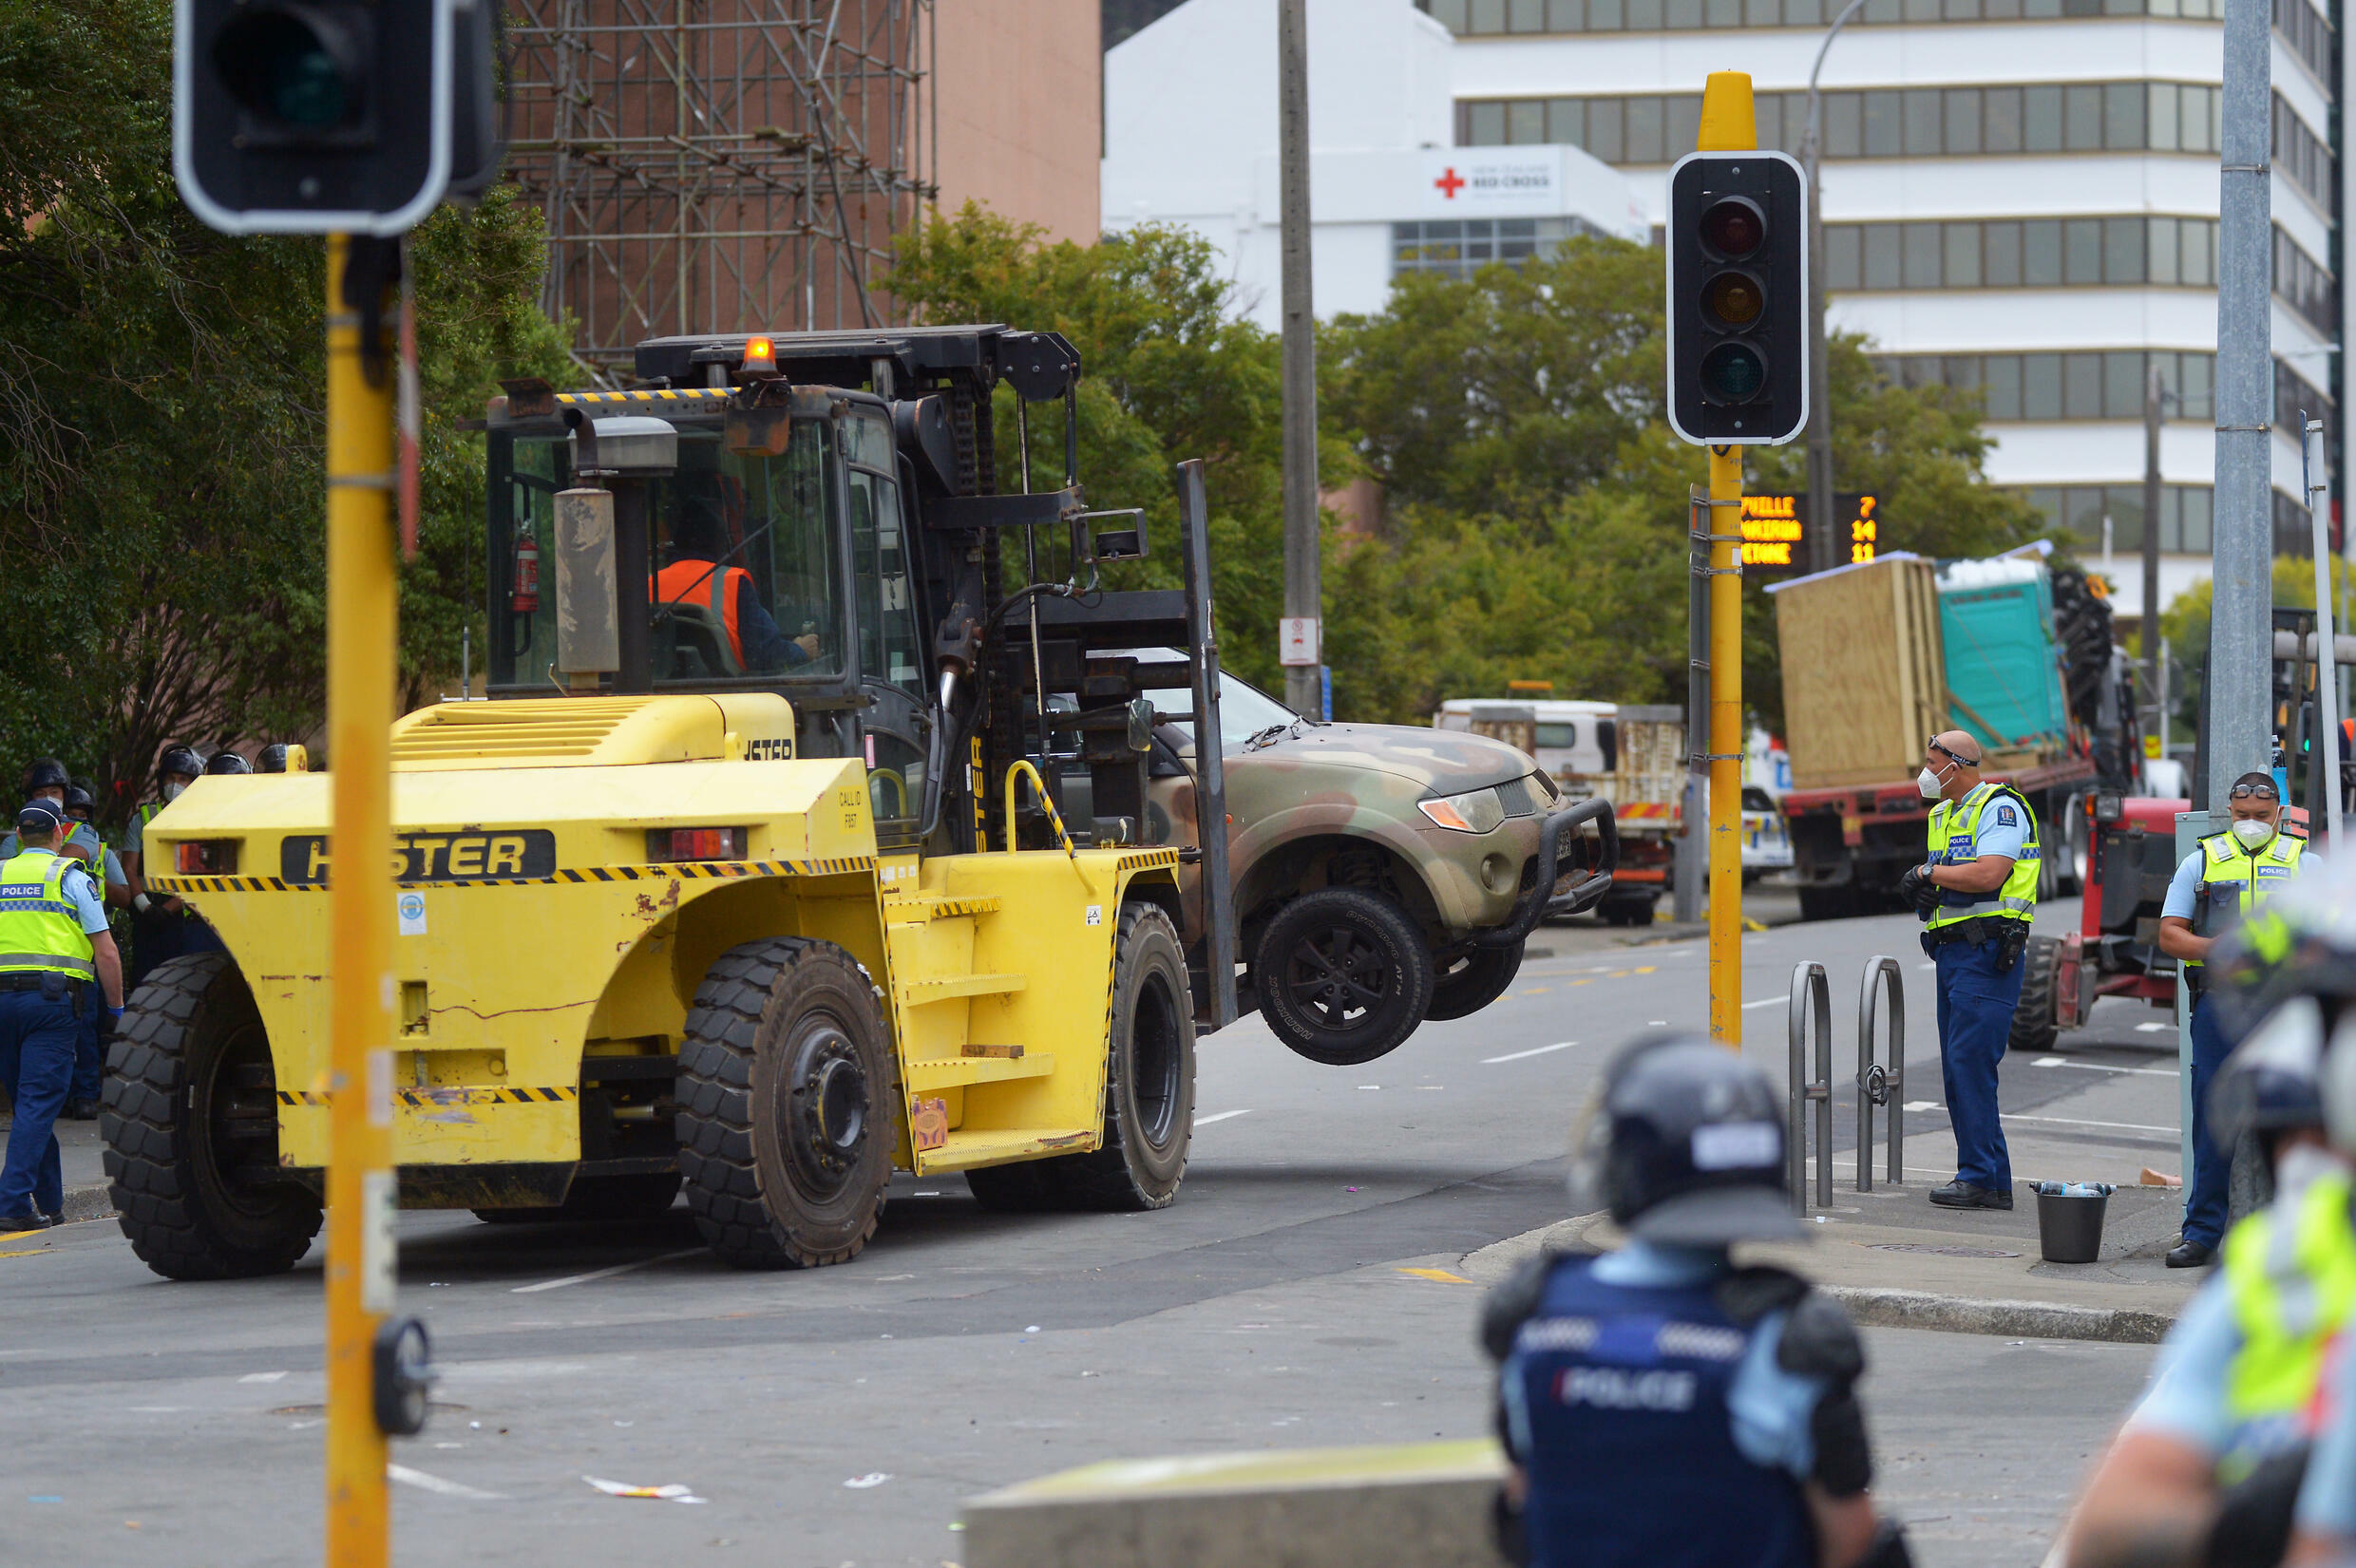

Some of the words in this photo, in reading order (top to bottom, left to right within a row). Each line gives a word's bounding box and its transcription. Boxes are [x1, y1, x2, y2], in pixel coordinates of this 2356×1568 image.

[1502, 176, 1549, 187] CROSS
[1860, 497, 1875, 518] 7
[1852, 520, 1876, 540] 14
[1852, 542, 1875, 563] 11
[308, 836, 525, 878] HSTER
[2, 886, 41, 896] POLICE
[1562, 1369, 1698, 1412] POLICE
